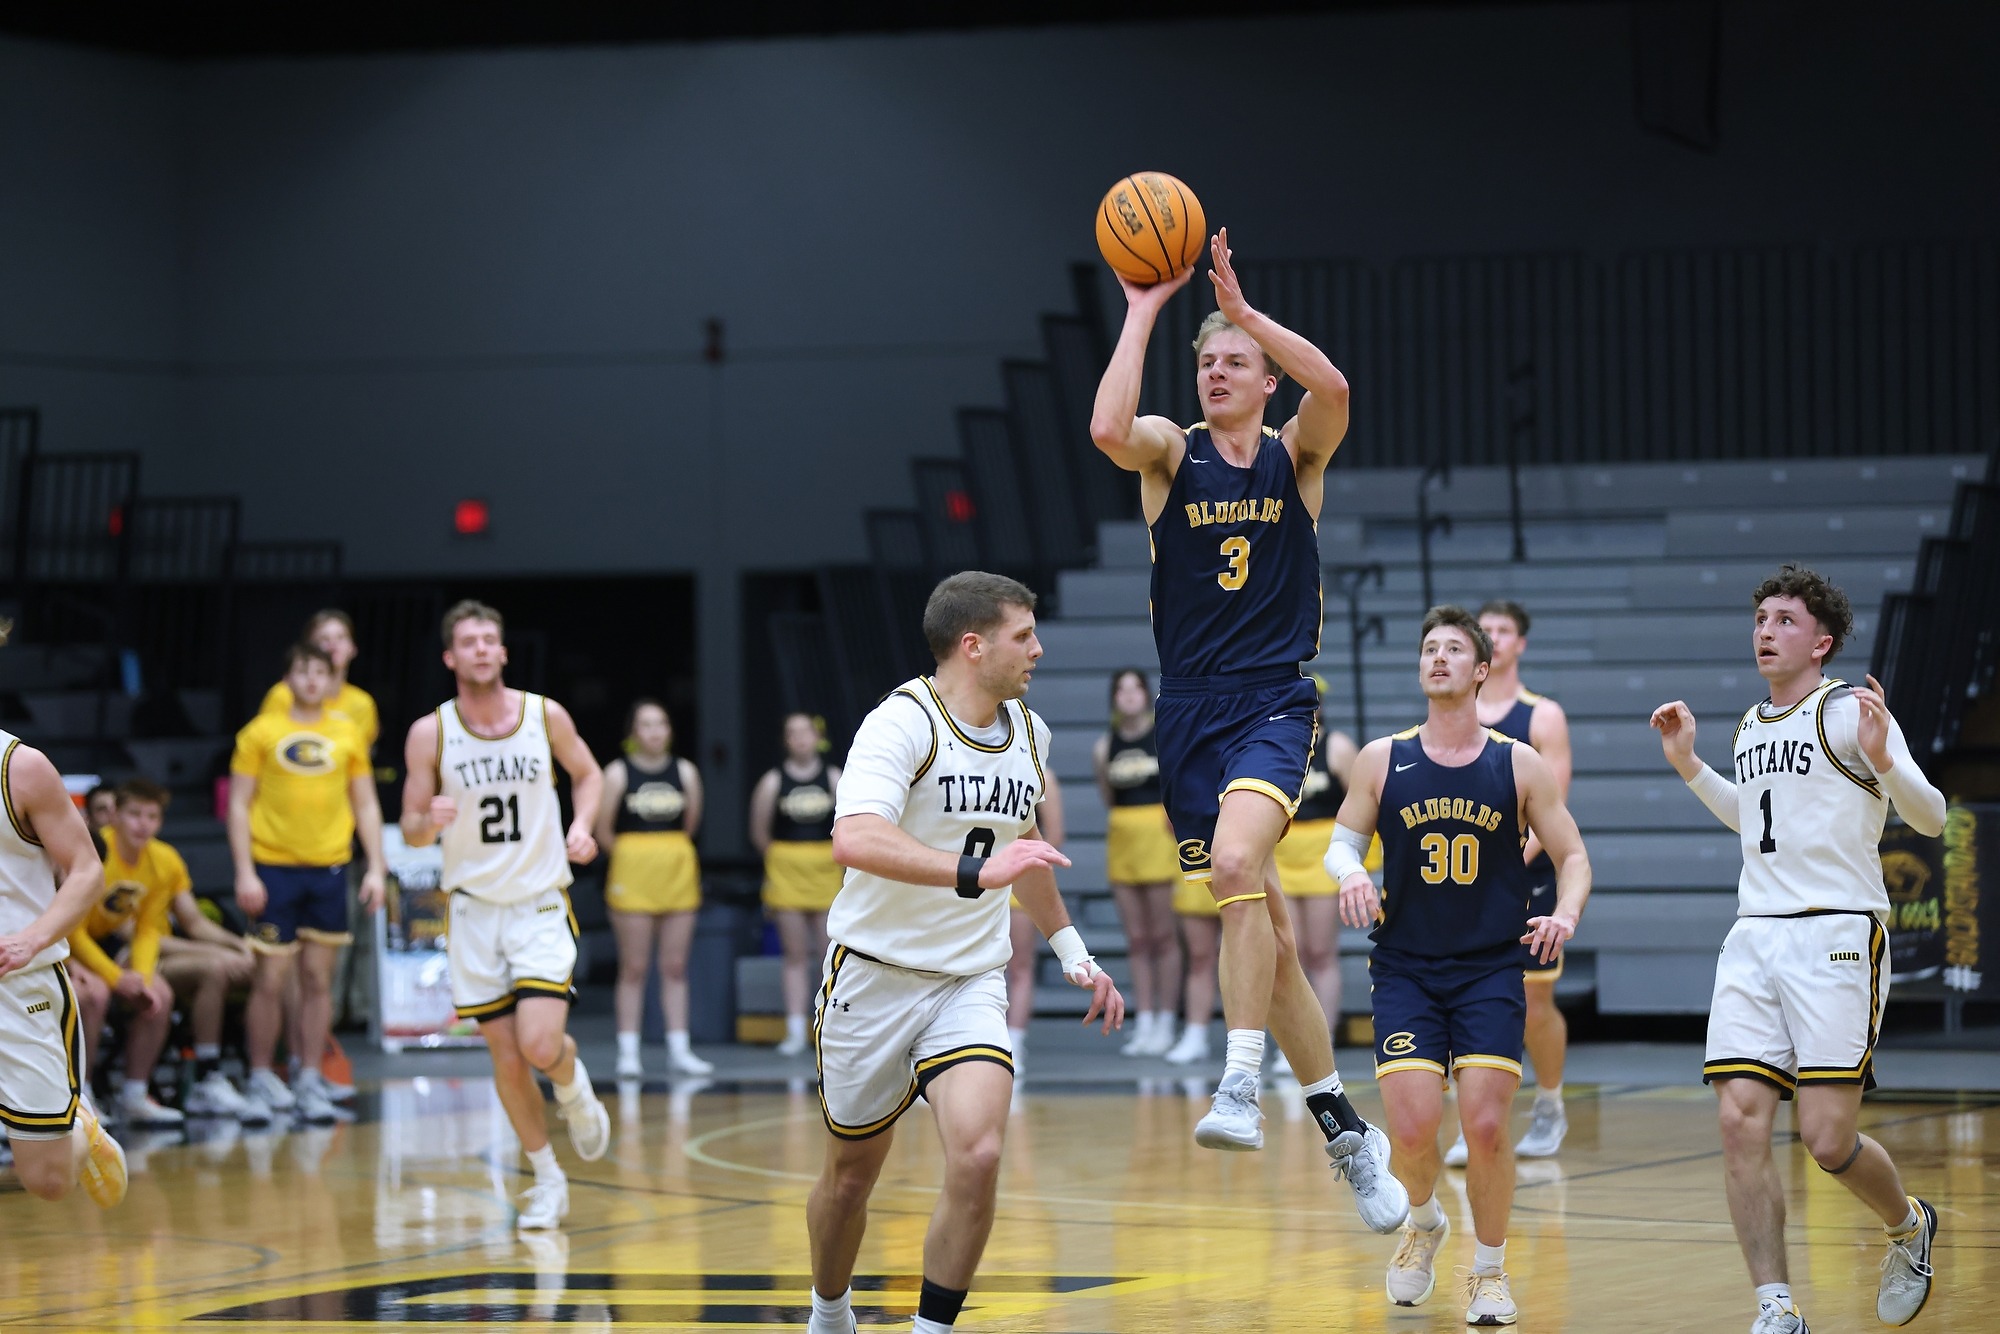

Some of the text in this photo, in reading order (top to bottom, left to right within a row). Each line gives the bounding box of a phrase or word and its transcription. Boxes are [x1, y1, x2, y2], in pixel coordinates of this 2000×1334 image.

[1217, 536, 1251, 591] 3
[454, 755, 540, 789] TITANS
[1736, 740, 1814, 784] TITANS
[479, 793, 522, 843] 21
[938, 774, 1035, 821] TITANS
[1399, 797, 1503, 832] BLUGOLDS
[1759, 789, 1777, 854] 1
[1420, 832, 1480, 885] 30
